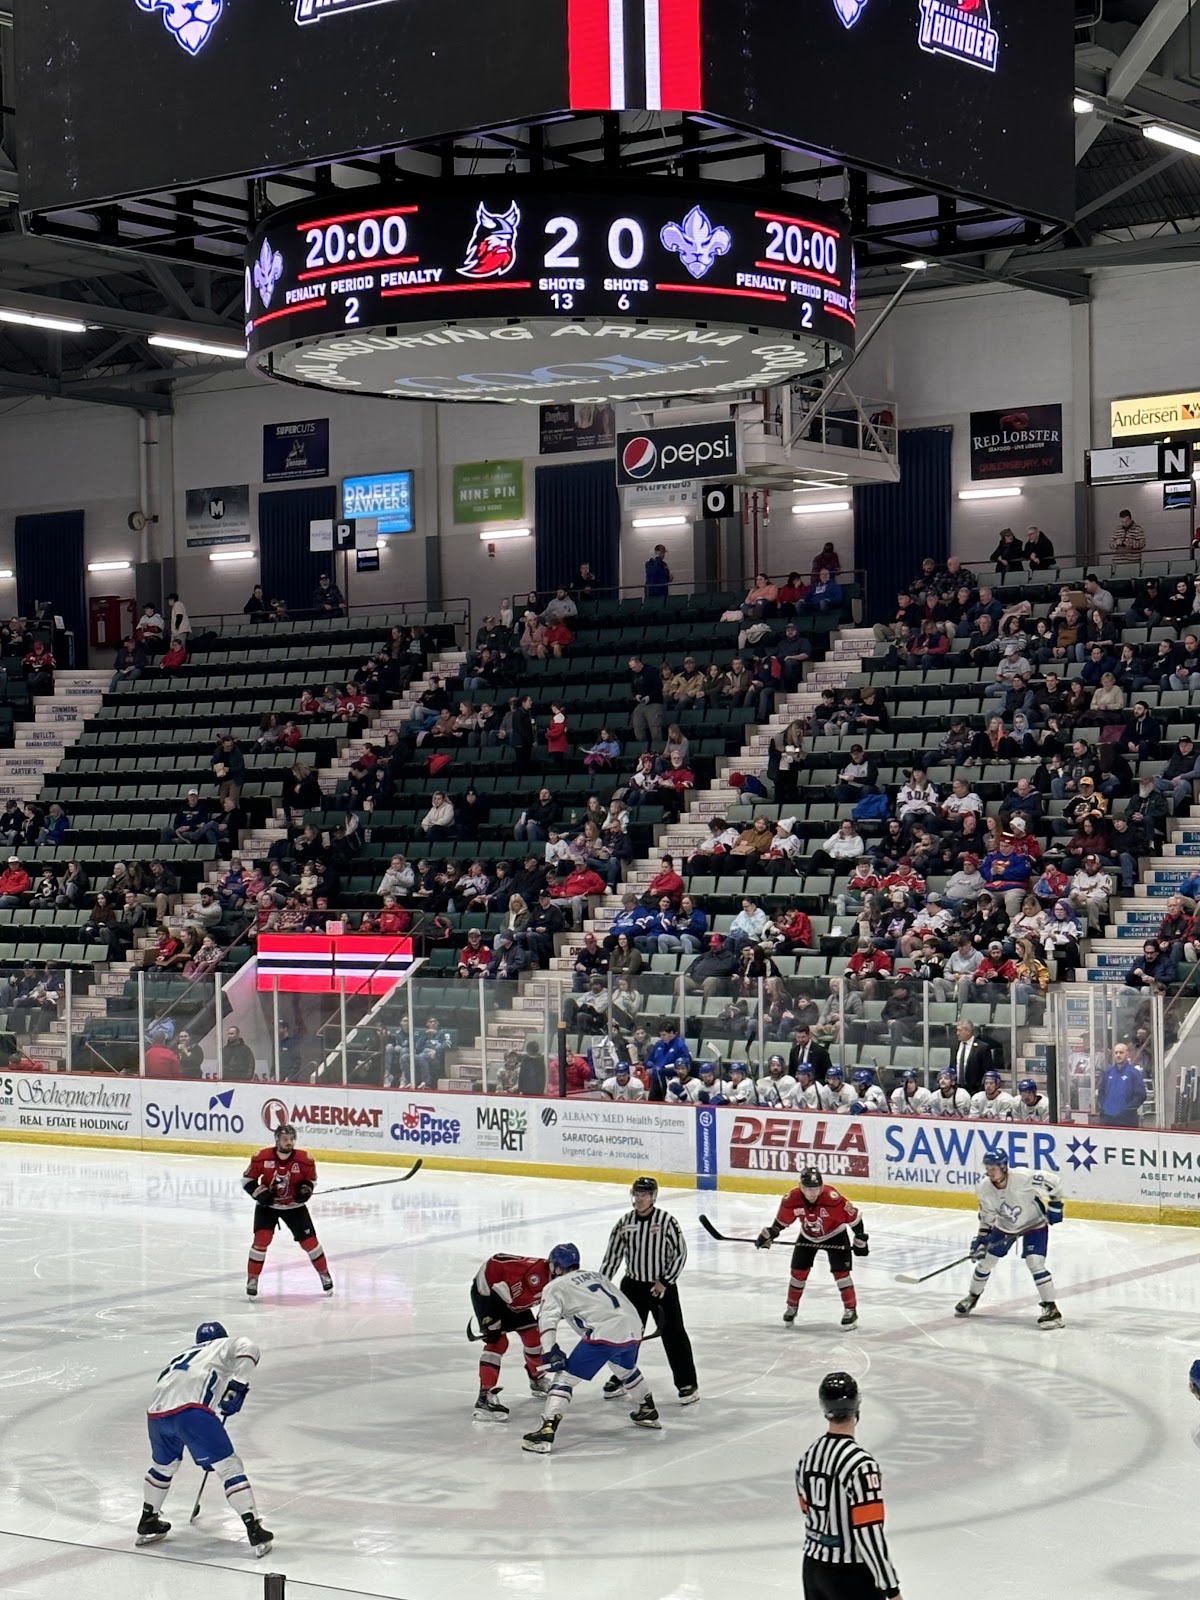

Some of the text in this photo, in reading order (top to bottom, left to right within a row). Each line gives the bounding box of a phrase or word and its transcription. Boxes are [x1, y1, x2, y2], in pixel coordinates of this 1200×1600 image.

[921, 0, 995, 62] THUNDER
[305, 215, 407, 268] 20:00
[544, 216, 580, 268] 2
[607, 217, 645, 270] 0
[765, 221, 838, 274] 20:00
[285, 268, 443, 304] PENALTY PERIOD PENALTY
[538, 277, 585, 291] SHOTS
[603, 278, 649, 292] SHOTS
[736, 272, 786, 292] PENALTY
[790, 281, 821, 300] PERIOD
[344, 297, 360, 324] 2
[550, 294, 574, 310] 13
[617, 294, 630, 311] 6
[800, 302, 813, 329] 2
[301, 326, 534, 363] INSURING
[550, 324, 743, 347] ARENA
[1112, 409, 1178, 428] Andersen
[275, 422, 316, 437] SUPERCUTS
[972, 430, 1060, 450] RED LOBSTER
[661, 434, 730, 470] pepsi
[1164, 448, 1186, 474] N
[345, 496, 400, 513] SAWYER
[460, 486, 516, 502] NINE PIN
[210, 500, 224, 517] M
[337, 524, 351, 545] P
[17, 1078, 131, 1108] Schermerhorn
[20, 1115, 42, 1126] REAL
[46, 1116, 77, 1128] ESTATE
[80, 1118, 129, 1131] HOLDINGS
[145, 1102, 244, 1135] Sylvamo
[290, 1104, 383, 1128] MEERKAT
[420, 1112, 460, 1131] Price
[562, 1111, 685, 1129] ALBANY MED Health System
[305, 1126, 328, 1134] Control
[334, 1127, 354, 1136] Critter
[355, 1129, 384, 1138] Removal
[390, 1123, 460, 1145] Chopper
[562, 1132, 644, 1146] SARATOGA HOSPITAL
[730, 1116, 867, 1153] DELLA
[562, 1147, 586, 1157] Urgent
[586, 1148, 603, 1157] Care
[885, 1125, 1060, 1172] SAWYER
[748, 1149, 850, 1175] AUTO GROUP
[887, 1167, 940, 1184] FAMILY
[1140, 1172, 1174, 1182] ASSET
[1140, 1188, 1172, 1198] Manager
[1182, 1190, 1196, 1199] the
[588, 1283, 620, 1309] 7
[809, 1476, 827, 1507] 10
[865, 1473, 880, 1489] 10
